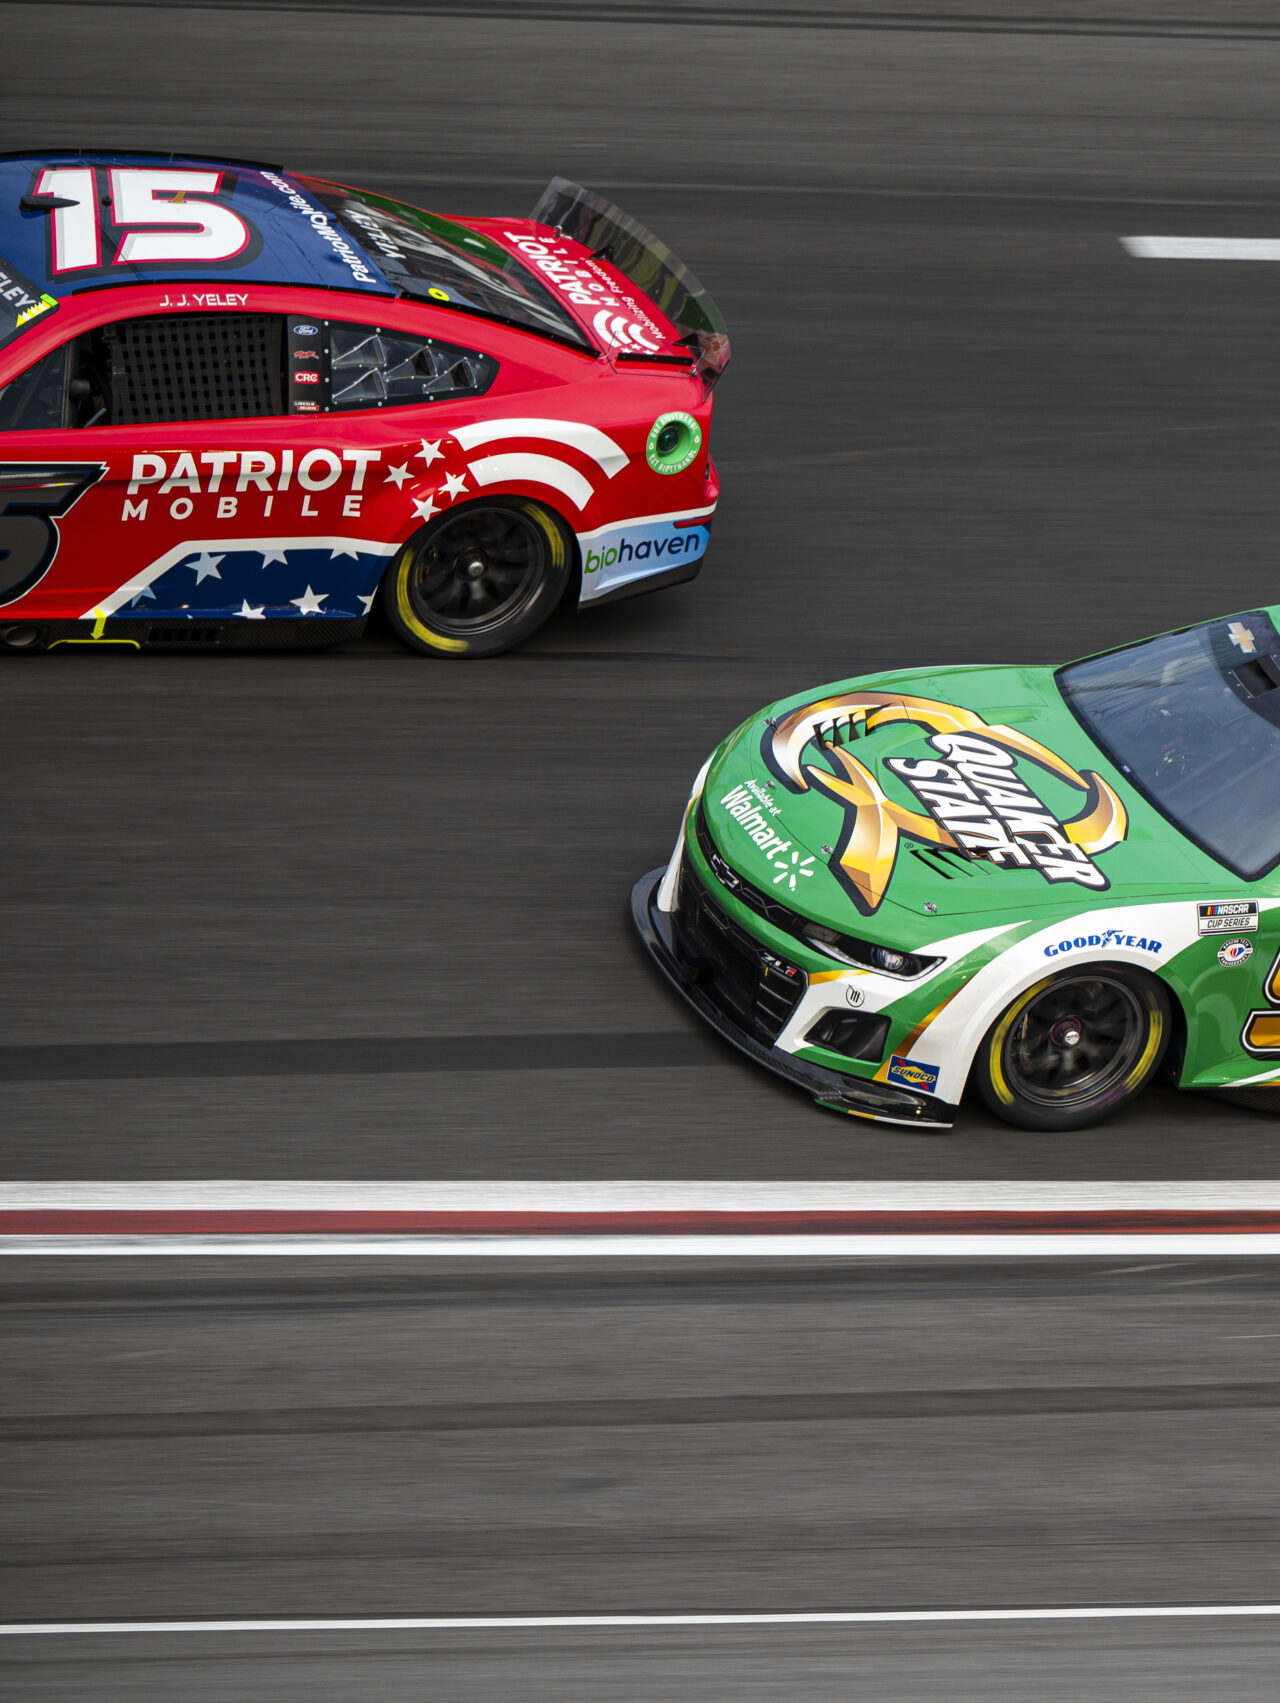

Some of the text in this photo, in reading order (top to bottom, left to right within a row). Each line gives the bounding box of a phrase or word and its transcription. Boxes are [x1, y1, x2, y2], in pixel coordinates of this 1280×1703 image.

[32, 167, 250, 276] 15
[503, 231, 601, 305] PATRIOT
[160, 293, 249, 307] J. J. YELEY
[297, 325, 315, 335] Ford
[621, 296, 666, 340] Mobilizing
[295, 373, 318, 383] CRC
[127, 448, 382, 495] PATRIOT
[121, 494, 363, 521] MOBILE
[584, 531, 699, 574] biohaven
[743, 779, 782, 816] Available at
[888, 734, 1106, 886] QUAKER STATE
[720, 784, 792, 860] Walmart
[1207, 917, 1251, 928] CUP SERIES
[1217, 903, 1250, 915] NASCAR
[1044, 930, 1162, 957] GOODYEAR
[890, 1065, 937, 1084] SUNOCO
